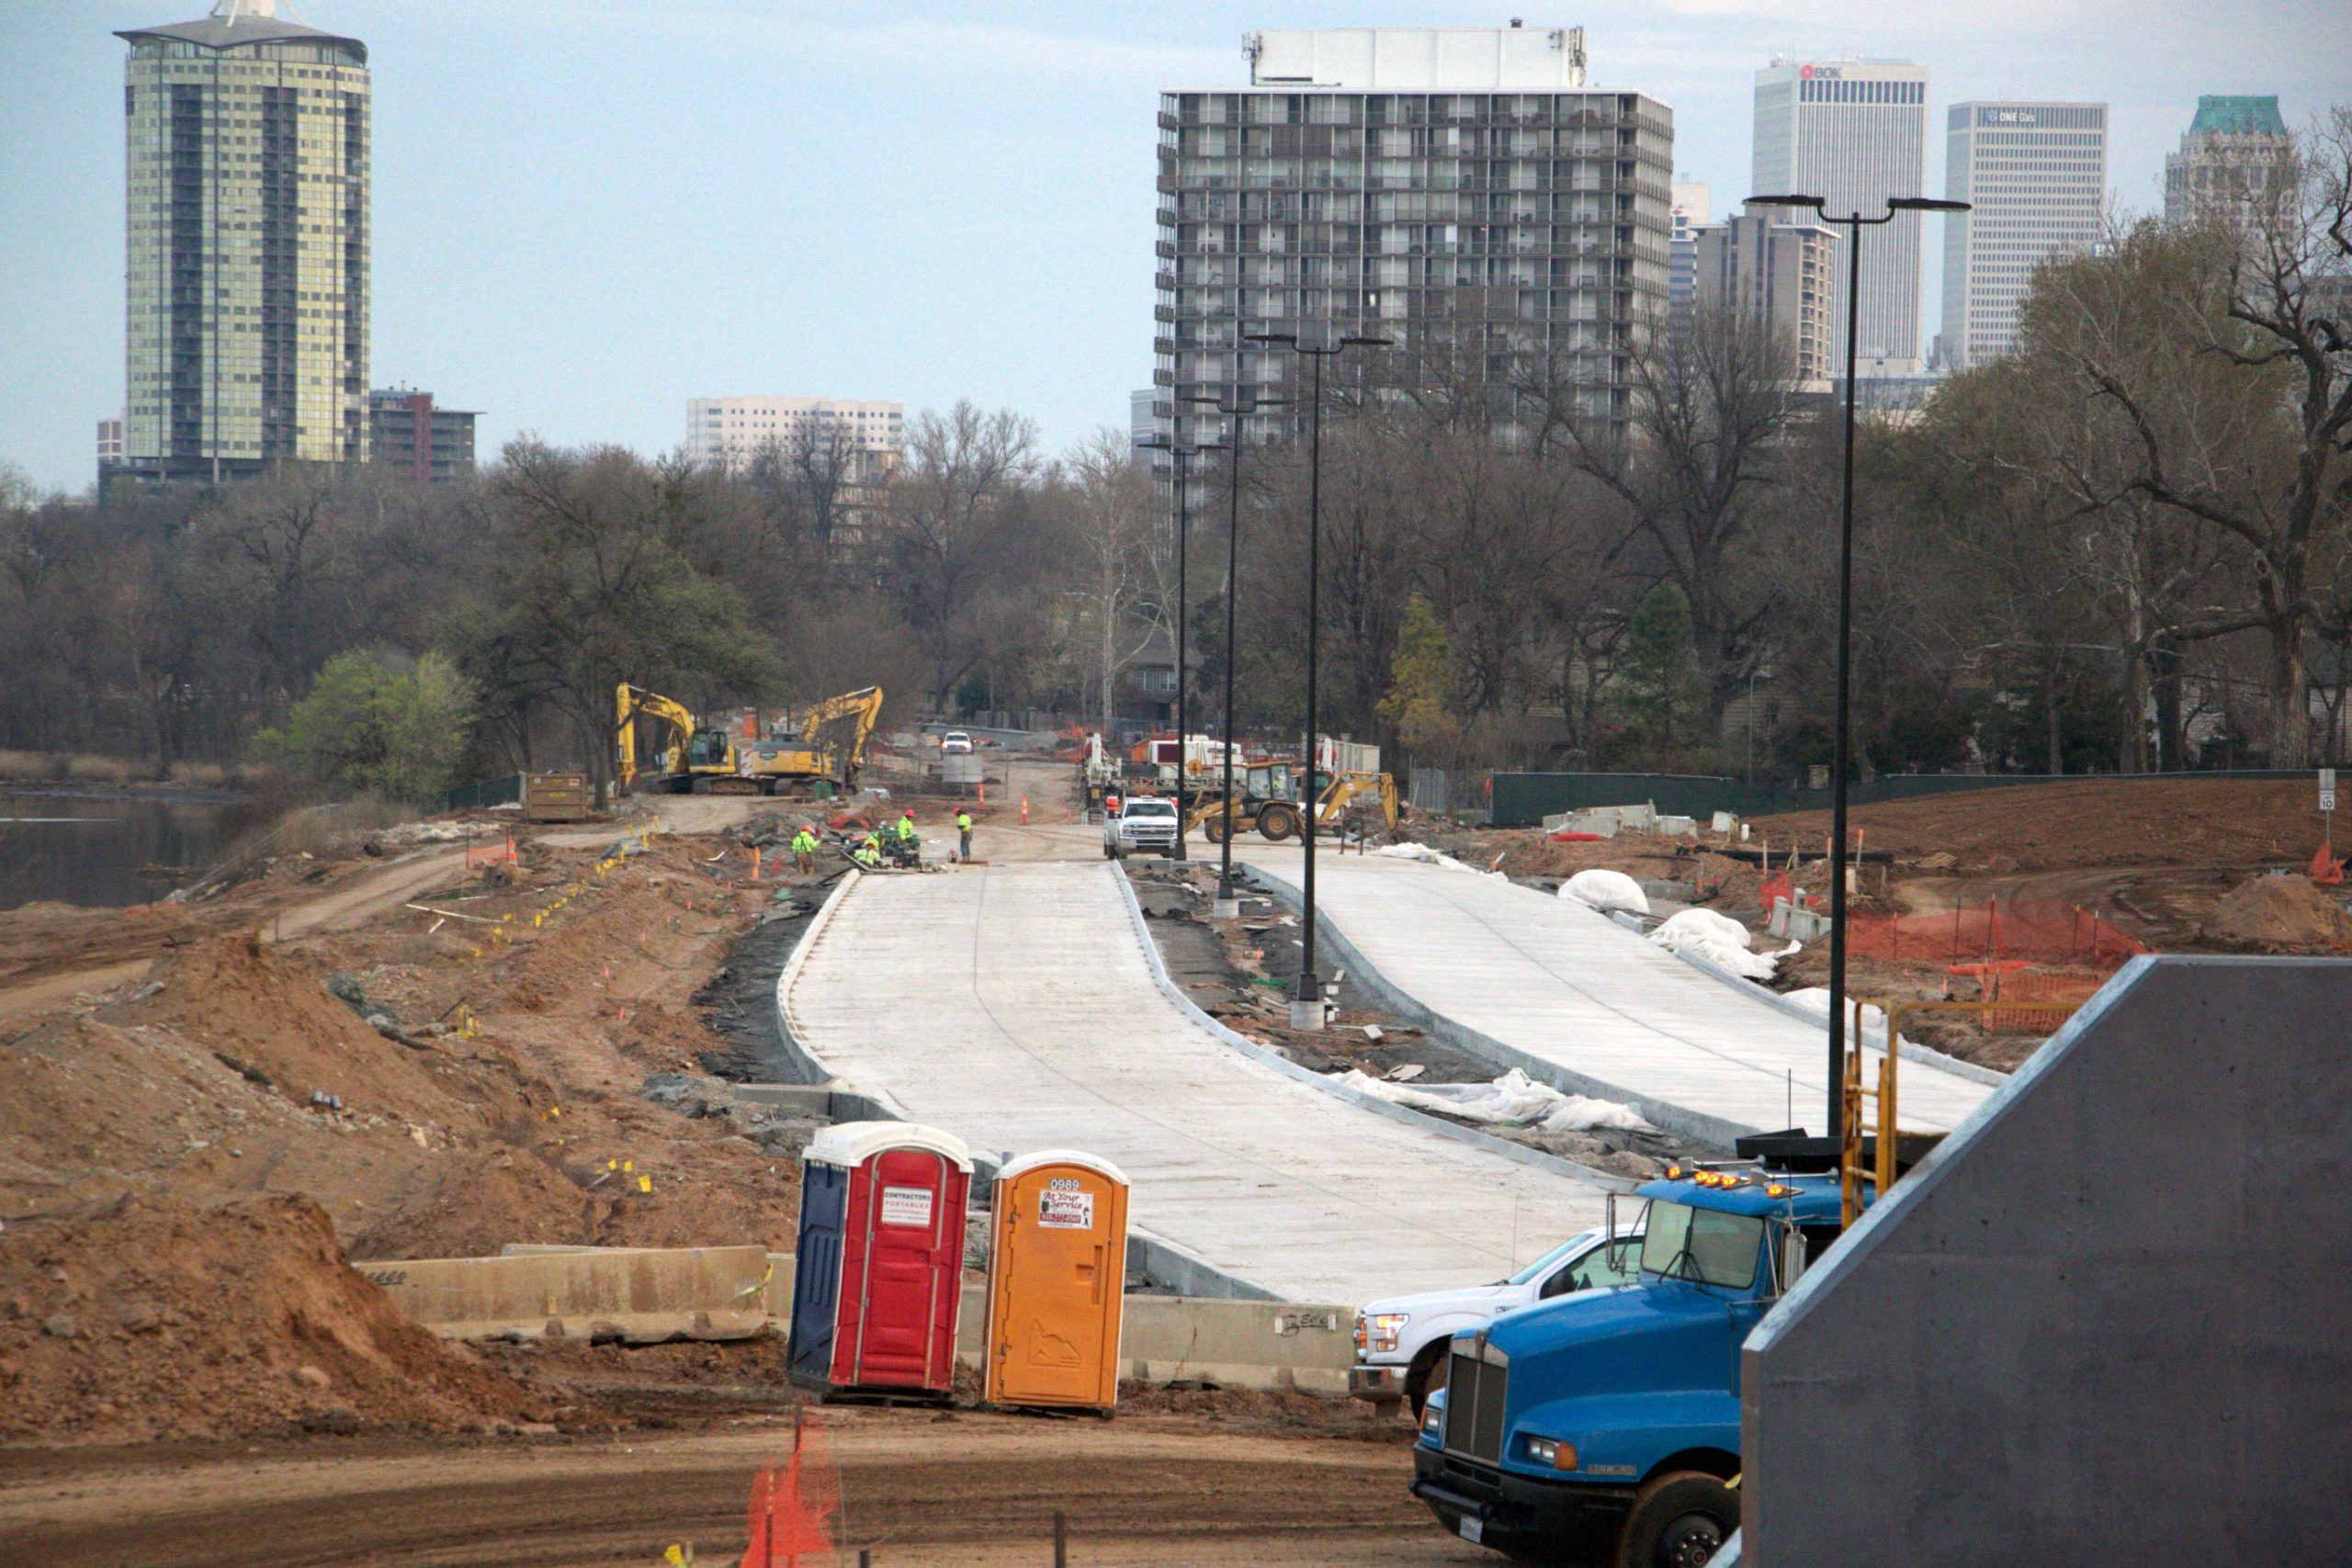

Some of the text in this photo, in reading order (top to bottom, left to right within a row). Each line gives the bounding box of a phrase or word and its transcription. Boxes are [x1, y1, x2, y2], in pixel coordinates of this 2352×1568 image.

[1815, 66, 1842, 79] BOK
[1999, 112, 2036, 122] ONE Gas
[2322, 800, 2333, 808] 10
[1050, 1179, 1080, 1190] 0989
[885, 1192, 931, 1201] CONTRACTORS
[1057, 1192, 1080, 1203] Your
[885, 1200, 929, 1209] PORTABLES
[1050, 1201, 1082, 1210] Service
